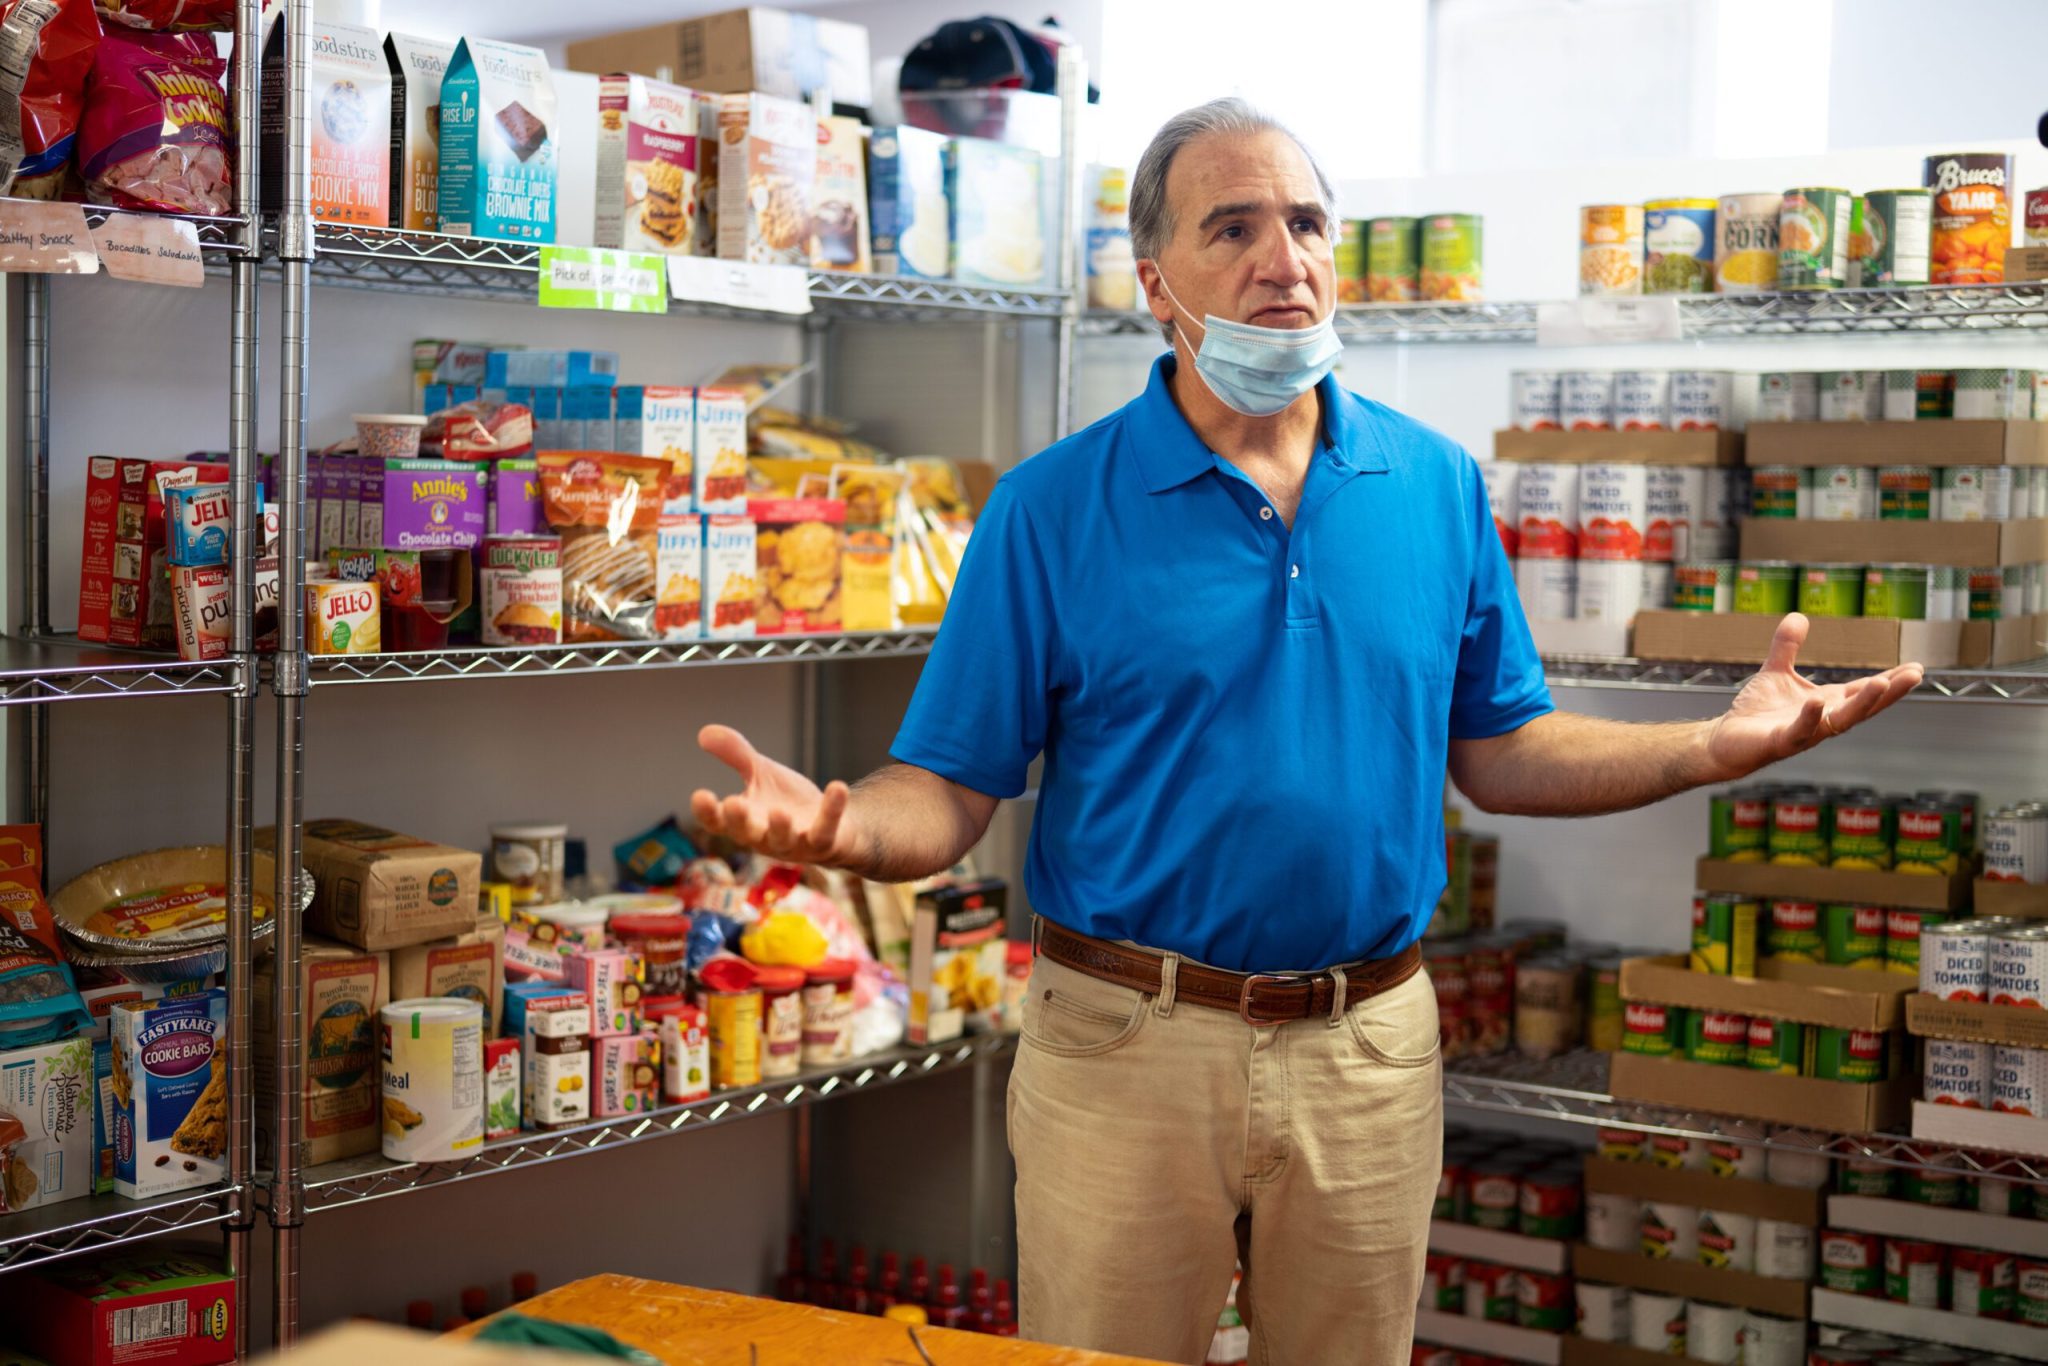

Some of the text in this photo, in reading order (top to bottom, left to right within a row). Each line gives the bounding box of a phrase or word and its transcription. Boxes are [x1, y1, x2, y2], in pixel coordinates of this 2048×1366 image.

[312, 38, 377, 61] oodstirs
[165, 94, 229, 136] Cookie
[442, 107, 460, 123] RISE
[311, 157, 351, 177] HOCOLATE
[1930, 159, 2005, 194] Bruce's
[358, 181, 380, 209] MIX
[1948, 191, 1996, 210] YAMS
[486, 193, 551, 224] BROWNIE MIX
[554, 267, 576, 281] Pick
[578, 271, 591, 282] of
[647, 403, 690, 421] JIFFY
[699, 404, 744, 423] JIFFY
[159, 474, 193, 489] Duncan
[412, 474, 469, 503] Annie's
[398, 530, 477, 548] Chocolate Chip
[712, 530, 752, 549] JIFFY
[198, 572, 223, 583] weis
[208, 591, 229, 603] instan
[173, 585, 195, 646] pudding
[0, 890, 31, 903] NACK
[124, 890, 211, 917] Ready Crust
[20, 916, 32, 926] 50
[1947, 957, 1982, 970] DICED
[1992, 961, 2026, 976] DICED
[169, 980, 200, 998] NEW
[140, 1017, 215, 1045] TASTYKAKE
[145, 1041, 211, 1065] COOKIE BARS
[308, 1057, 345, 1076] HUDSON
[1933, 1062, 1968, 1078] DICED
[27, 1066, 35, 1107] Breakfast
[384, 1071, 409, 1089] Meal
[64, 1072, 82, 1134] Nature's
[215, 1302, 224, 1337] MOTT'S
